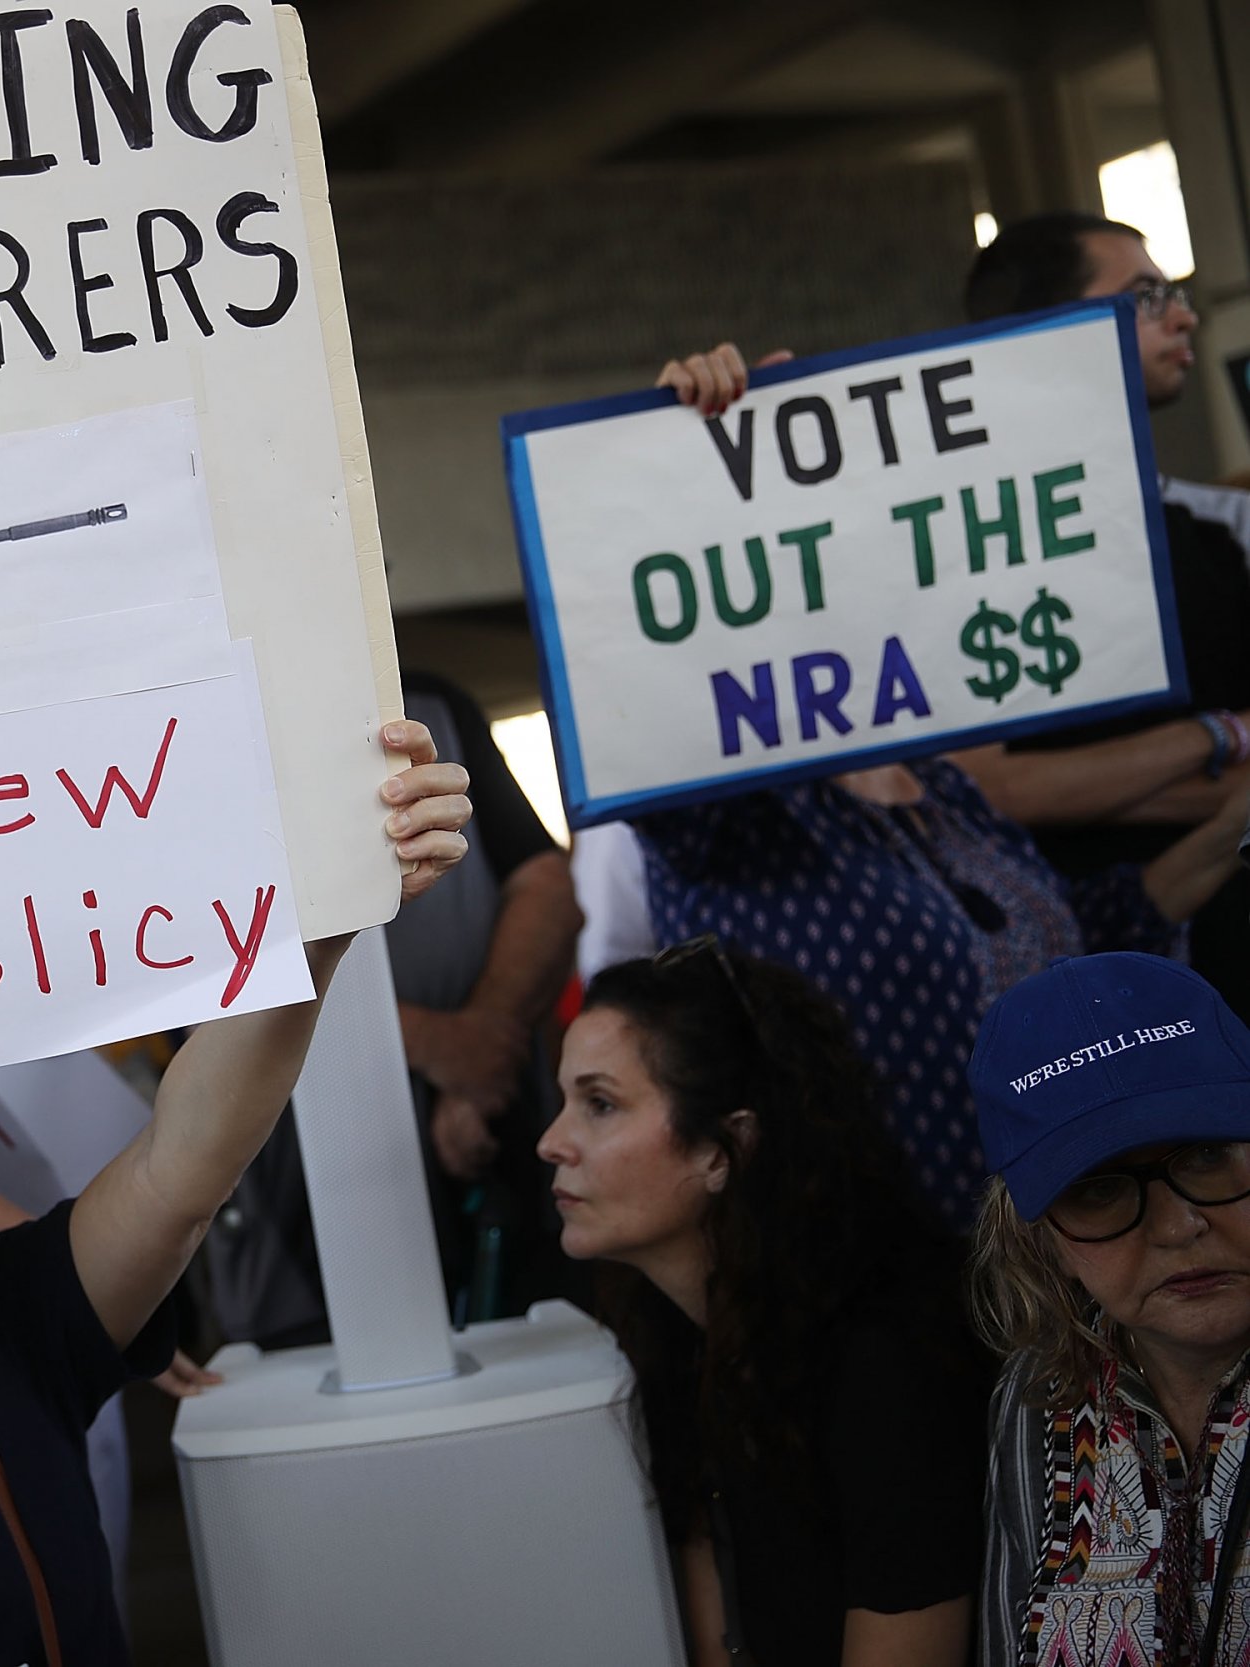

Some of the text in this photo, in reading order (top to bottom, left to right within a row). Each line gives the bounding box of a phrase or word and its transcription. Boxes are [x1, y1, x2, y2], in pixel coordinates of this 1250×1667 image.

[704, 359, 989, 501] VOTE
[634, 462, 1096, 643] OUT THE
[711, 636, 932, 756] NRA
[1010, 1019, 1196, 1095] WE'RE STILL HERE
